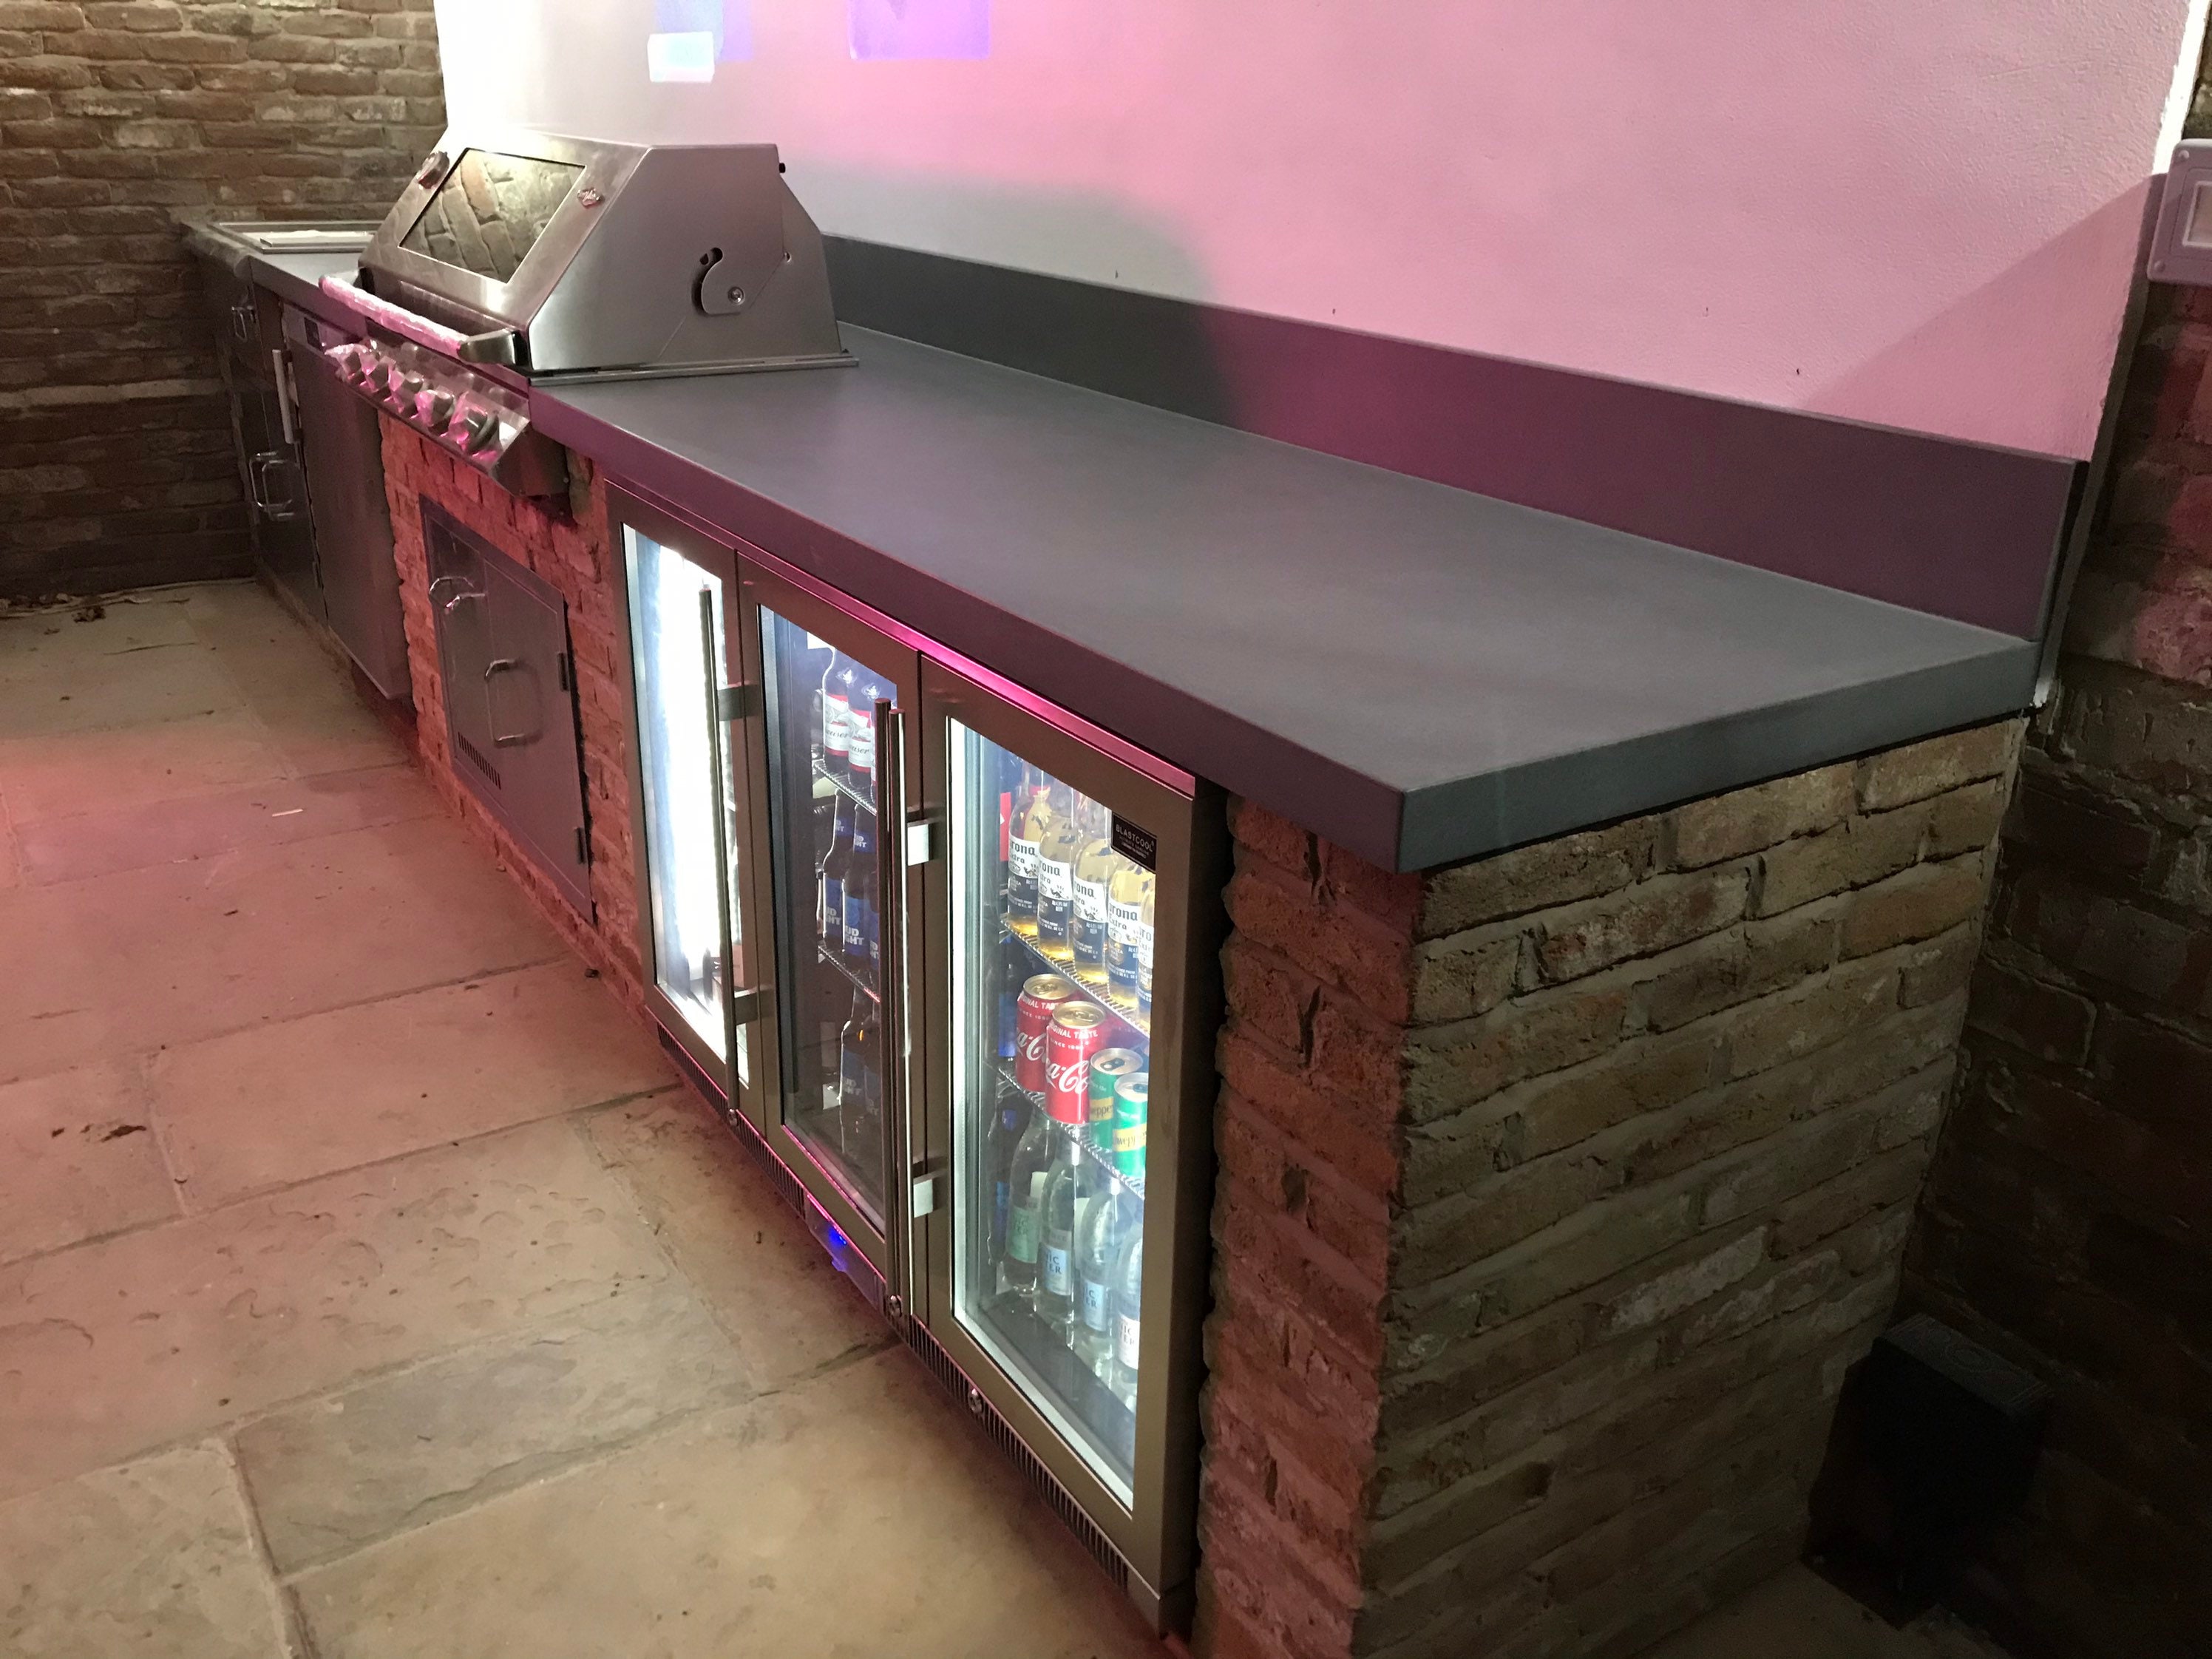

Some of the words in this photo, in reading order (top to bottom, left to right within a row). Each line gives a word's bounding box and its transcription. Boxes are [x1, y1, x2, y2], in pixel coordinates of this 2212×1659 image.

[1116, 824, 1153, 852] BLASTCOOL
[1010, 841, 1036, 856] rona
[1039, 861, 1060, 877] rona
[1074, 881, 1094, 898] rona
[845, 925, 859, 937] UD
[845, 933, 864, 945] GHT
